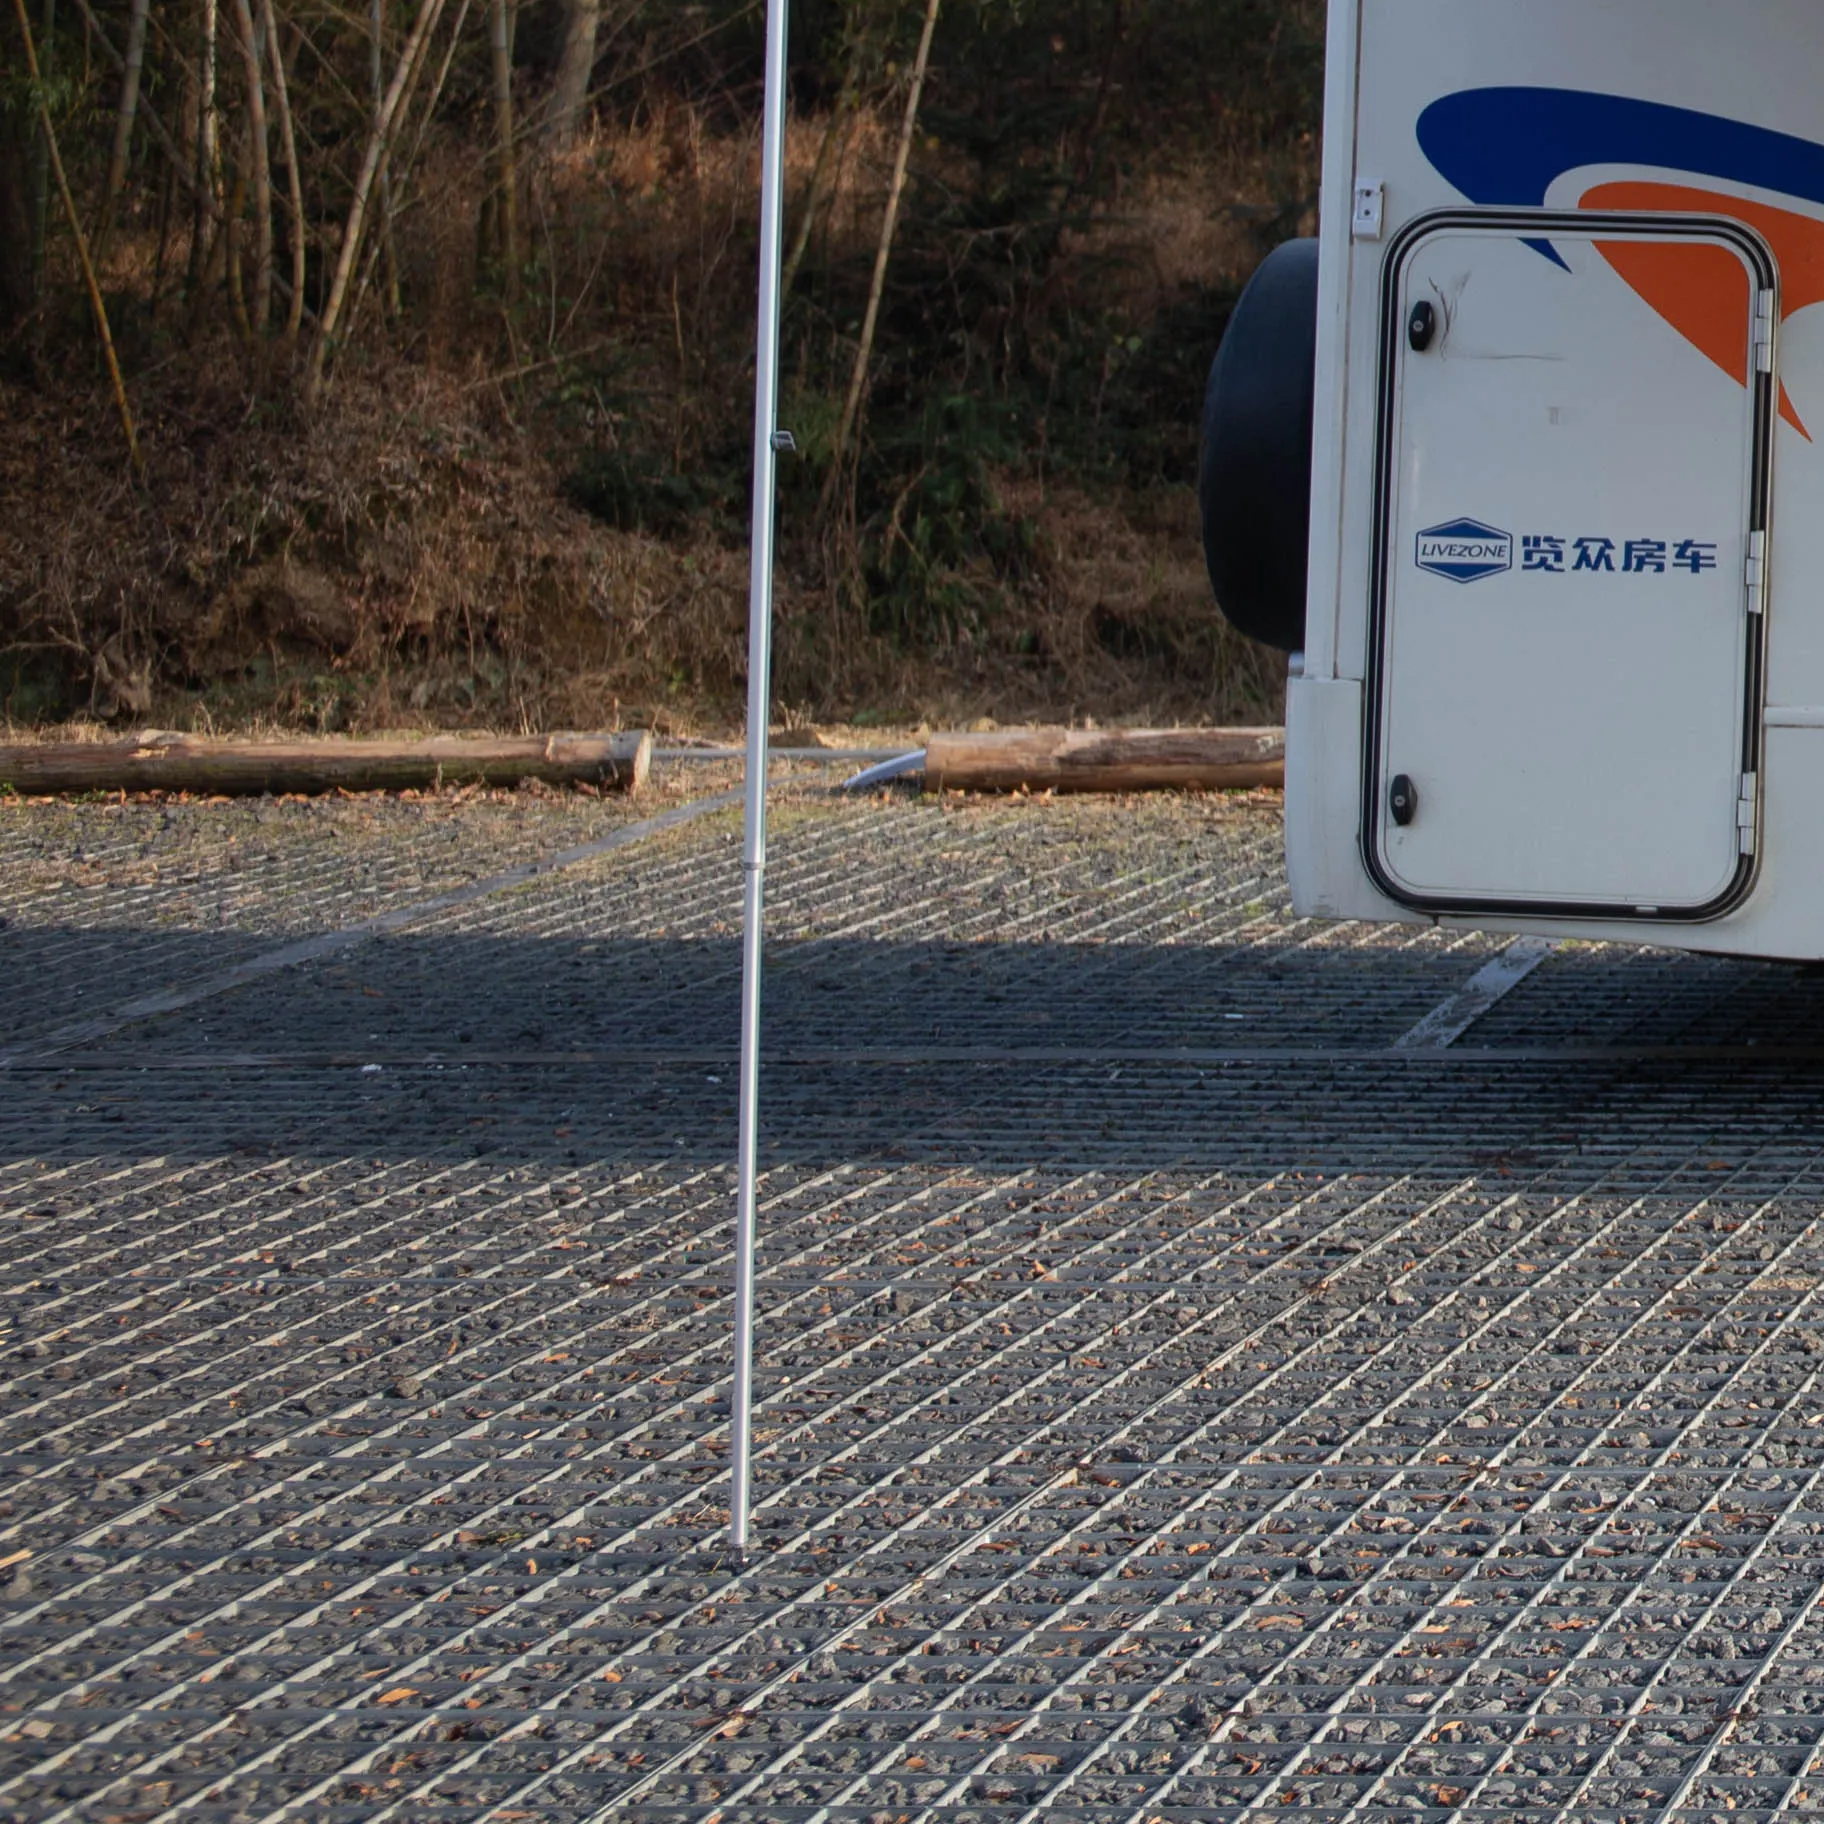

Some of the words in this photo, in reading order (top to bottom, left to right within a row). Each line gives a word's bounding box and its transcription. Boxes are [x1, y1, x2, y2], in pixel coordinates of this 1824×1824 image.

[1421, 542, 1507, 558] LIVEZONE
[1521, 535, 1718, 574] 览众房车
